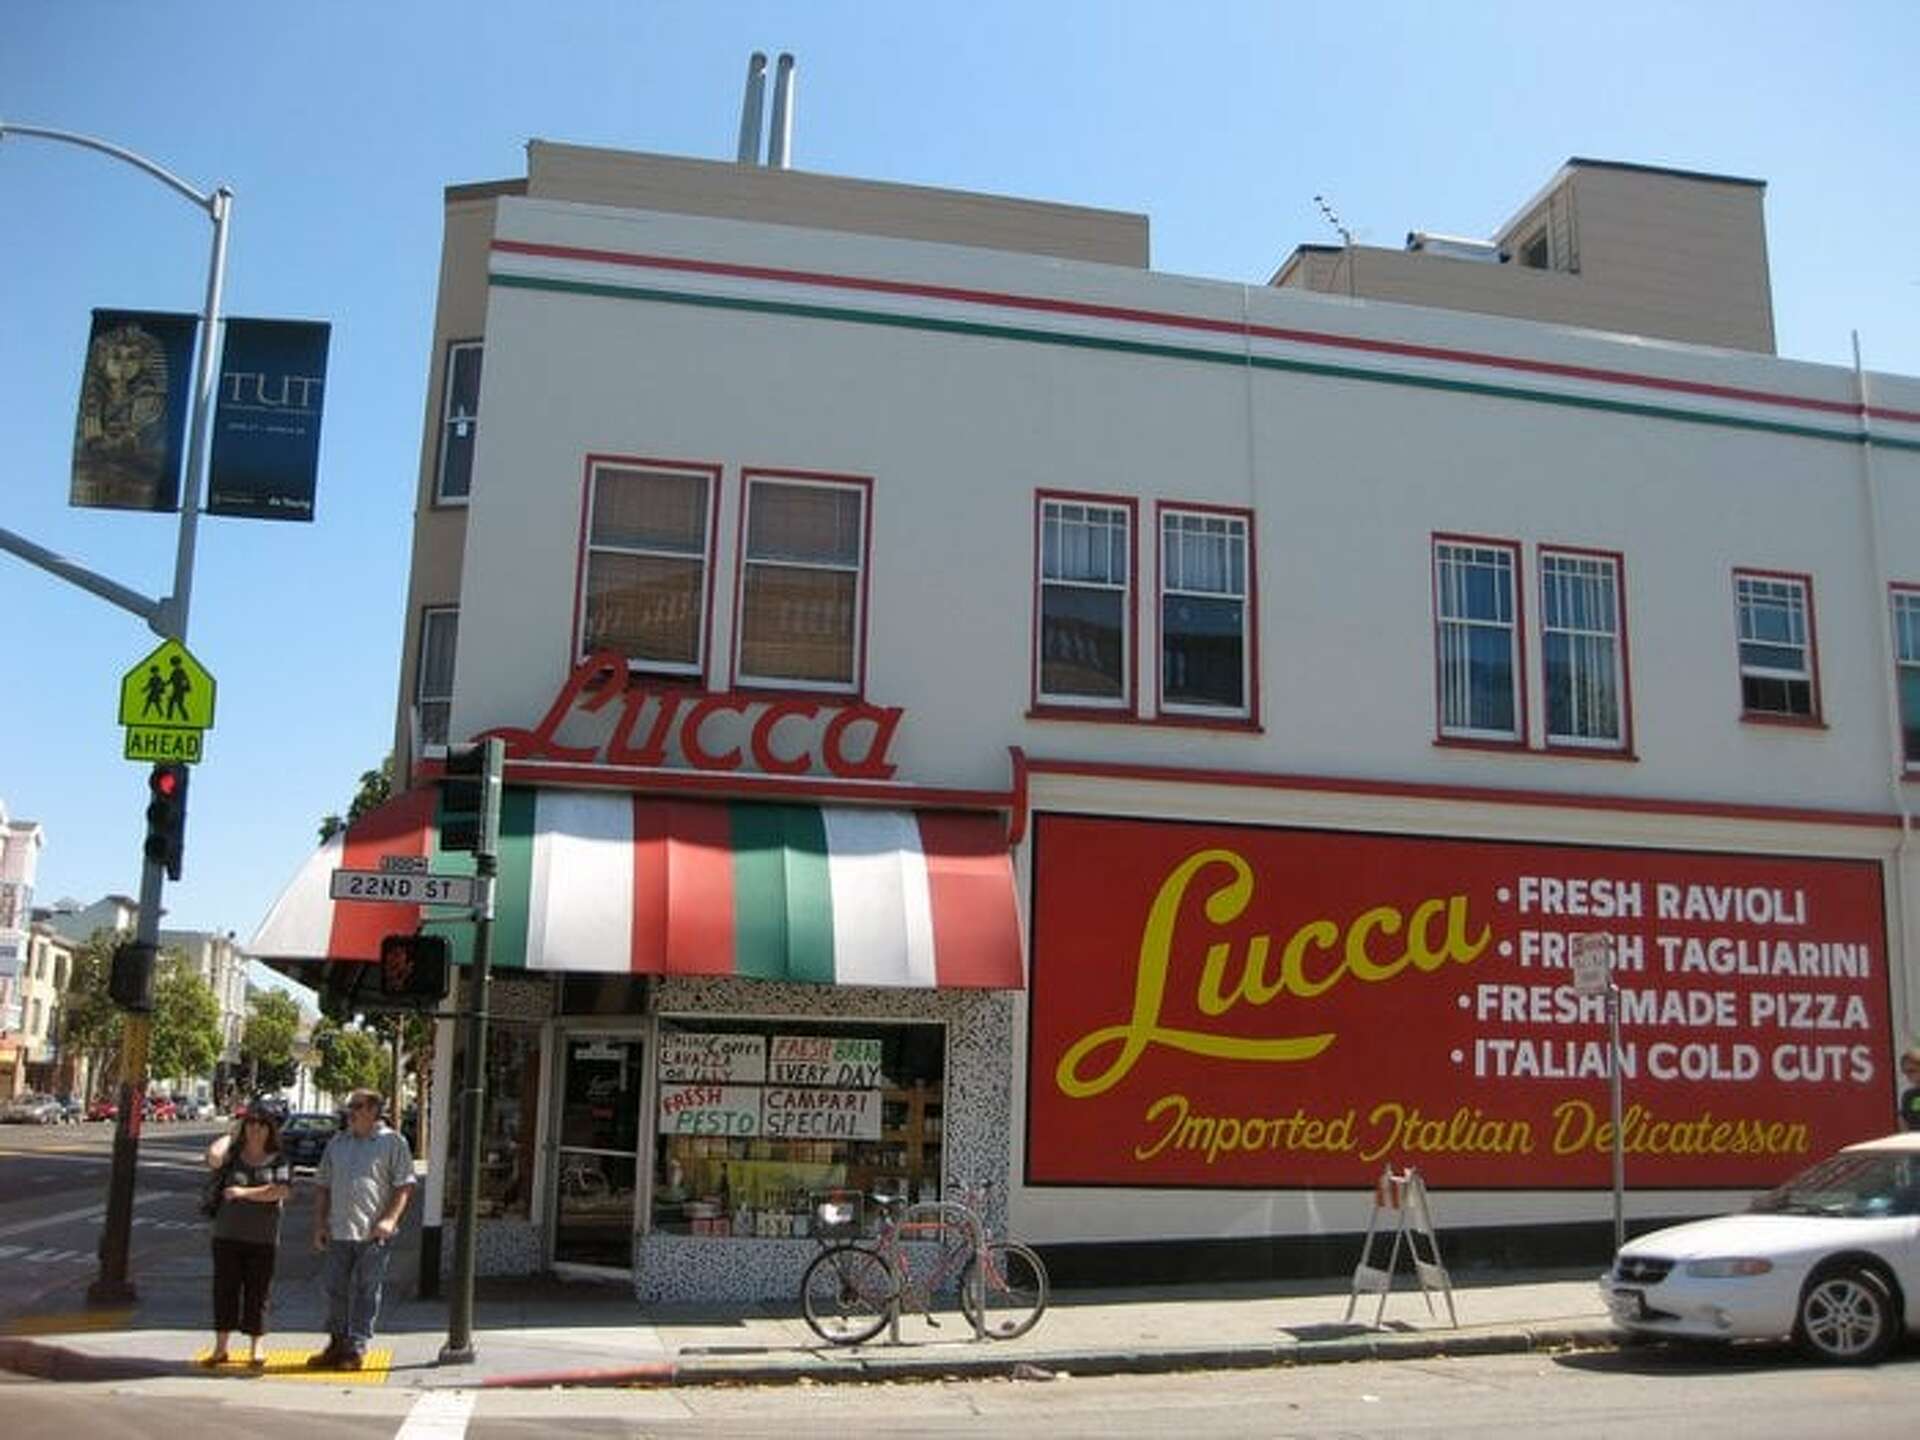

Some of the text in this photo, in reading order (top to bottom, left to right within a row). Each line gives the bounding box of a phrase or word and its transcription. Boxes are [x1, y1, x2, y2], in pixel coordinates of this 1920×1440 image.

[223, 371, 322, 408] TUT
[468, 650, 904, 780] Lucca
[130, 731, 199, 757] AHEAD
[350, 875, 451, 899] 22ND ST
[1518, 876, 1805, 924] FRESH RAVIOLI
[1056, 848, 1491, 1098] Lucca
[1657, 937, 1869, 978] TAGLIARINI
[1477, 984, 1869, 1029] FRESH MADE PIZZA
[776, 1062, 880, 1087] EVERY DAY
[1475, 1039, 1874, 1082] ITALIAN COLD CUTS
[663, 1087, 722, 1115] FRESH
[767, 1090, 868, 1114] CAMPARI
[676, 1110, 755, 1133] PESTO
[767, 1112, 862, 1137] SPECIAL
[1135, 1095, 1808, 1163] Imported Italian Delicatessen
